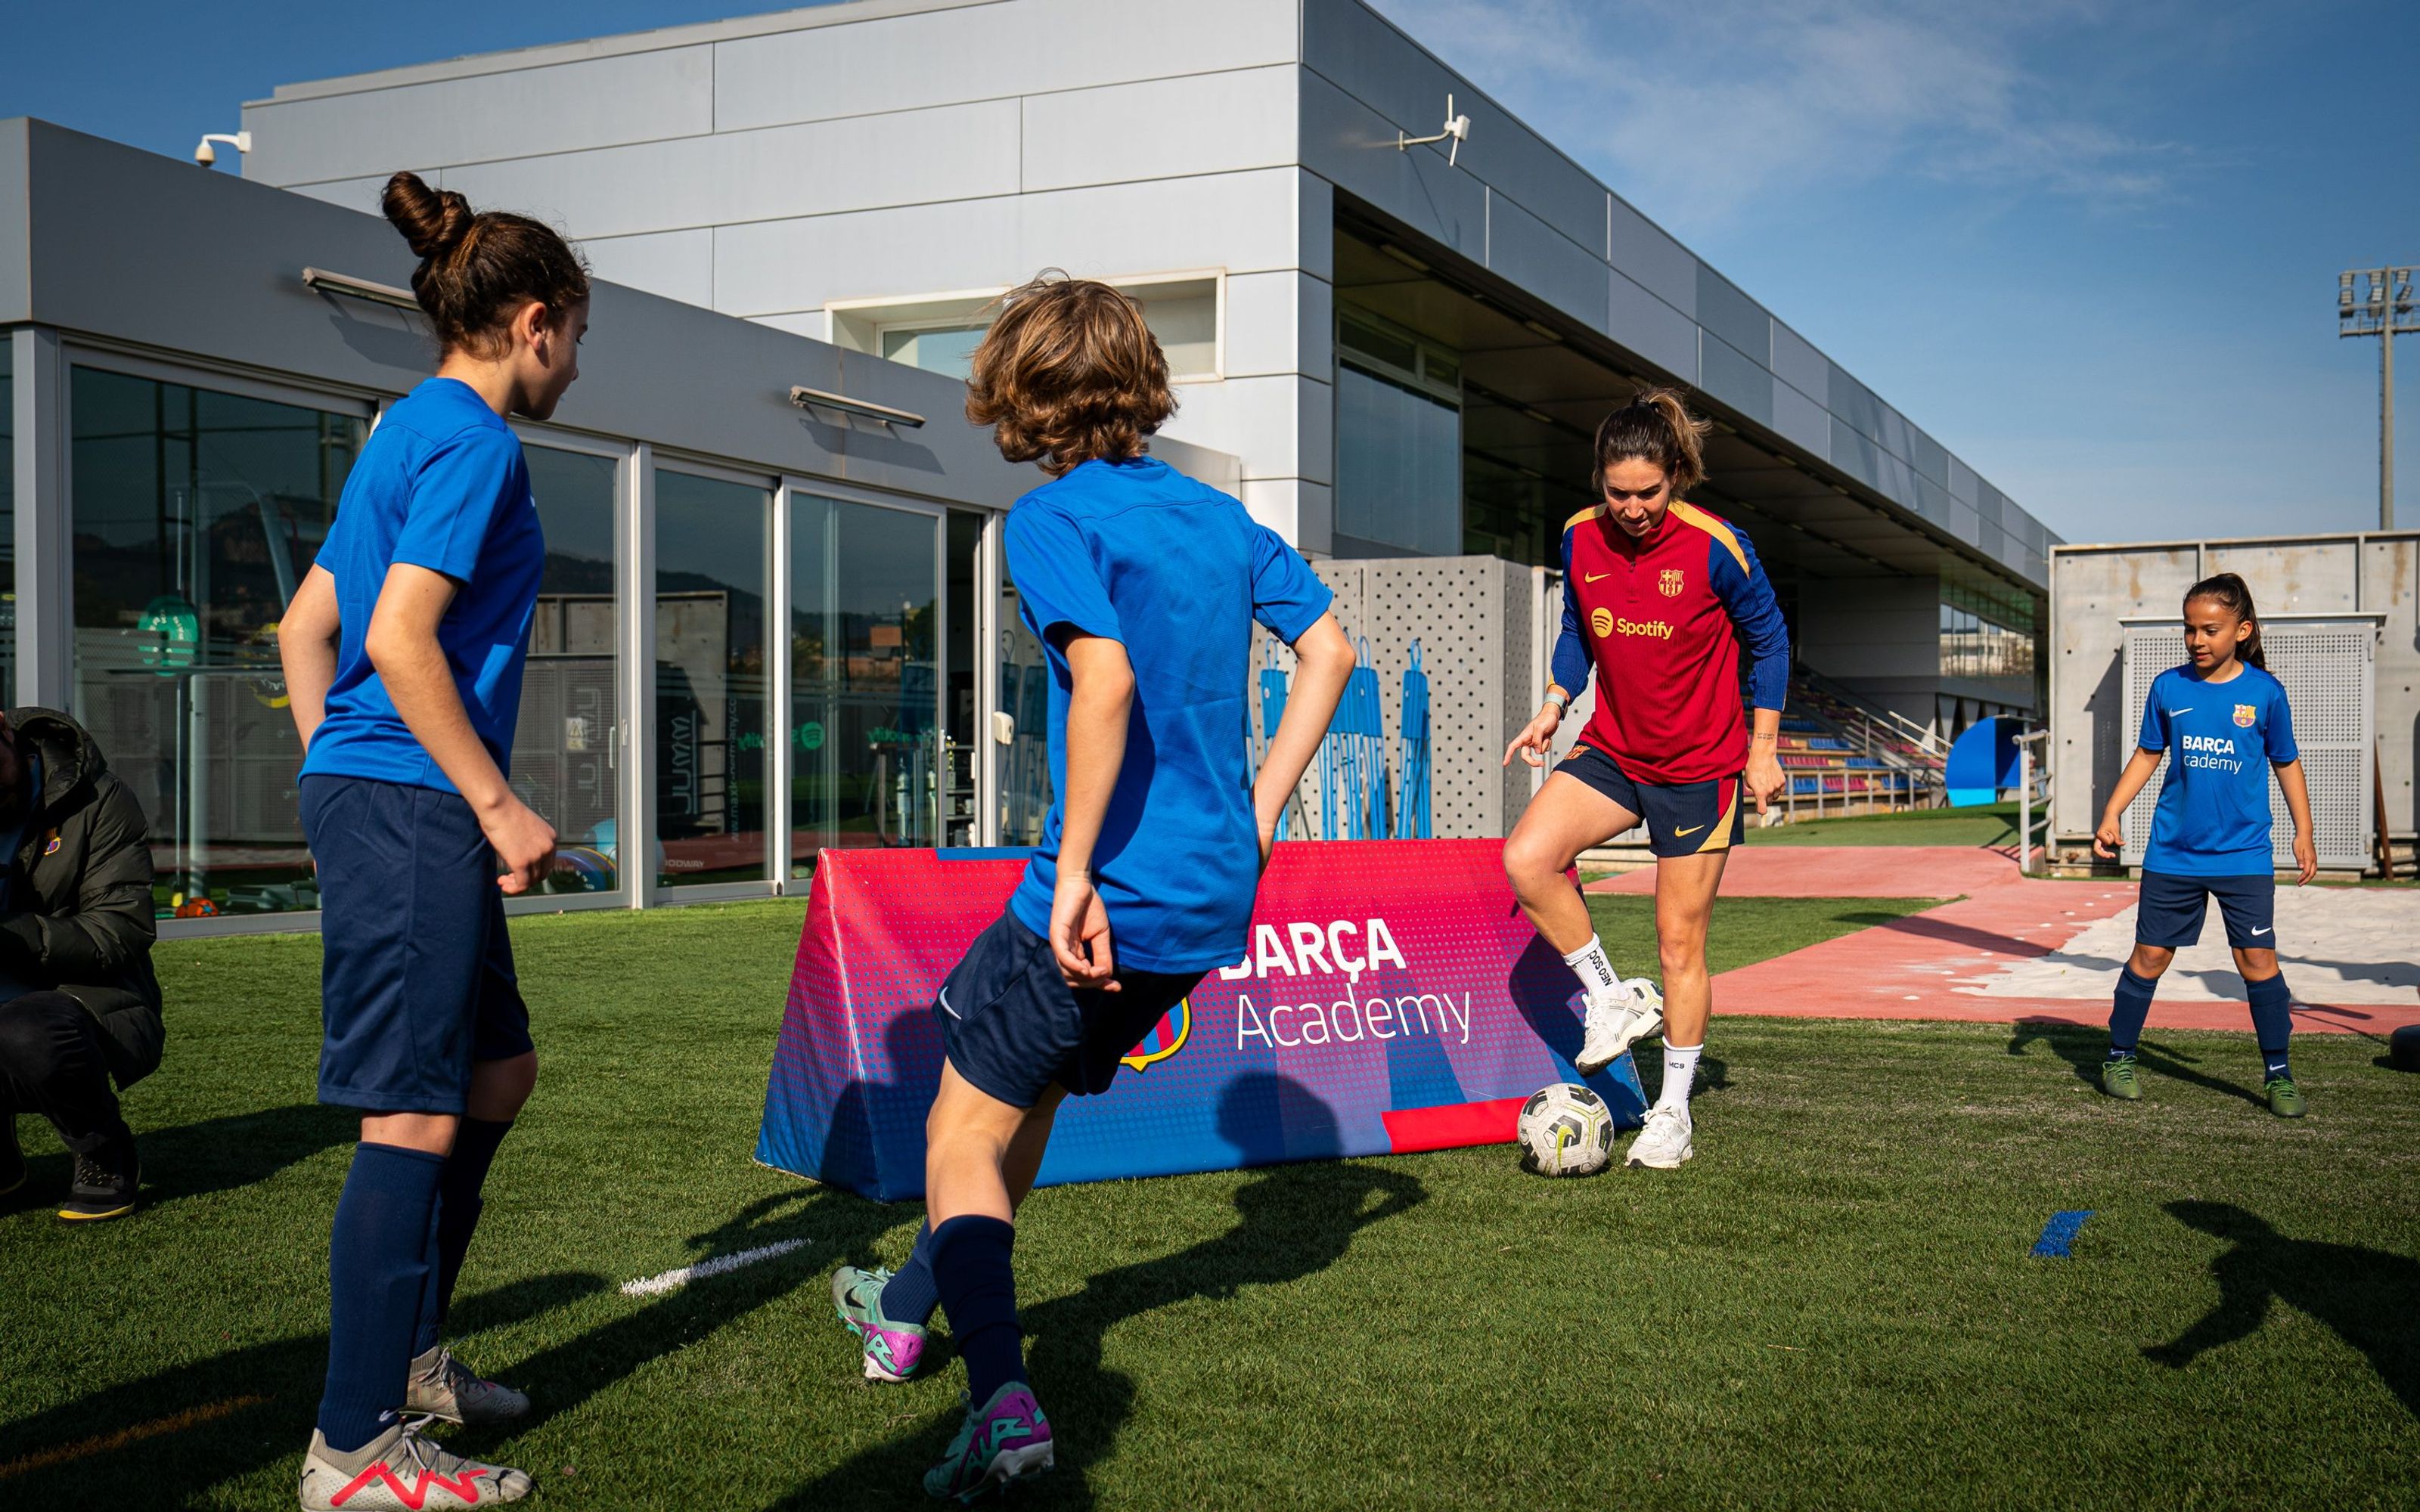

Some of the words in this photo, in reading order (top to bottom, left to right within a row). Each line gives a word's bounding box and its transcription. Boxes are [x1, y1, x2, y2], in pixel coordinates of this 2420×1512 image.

[1616, 618, 1674, 640] Spotify
[2183, 735, 2235, 755] BARÇA
[2183, 753, 2243, 775] cademy
[1598, 968, 1614, 987] NEO
[1237, 983, 1470, 1051] Academy
